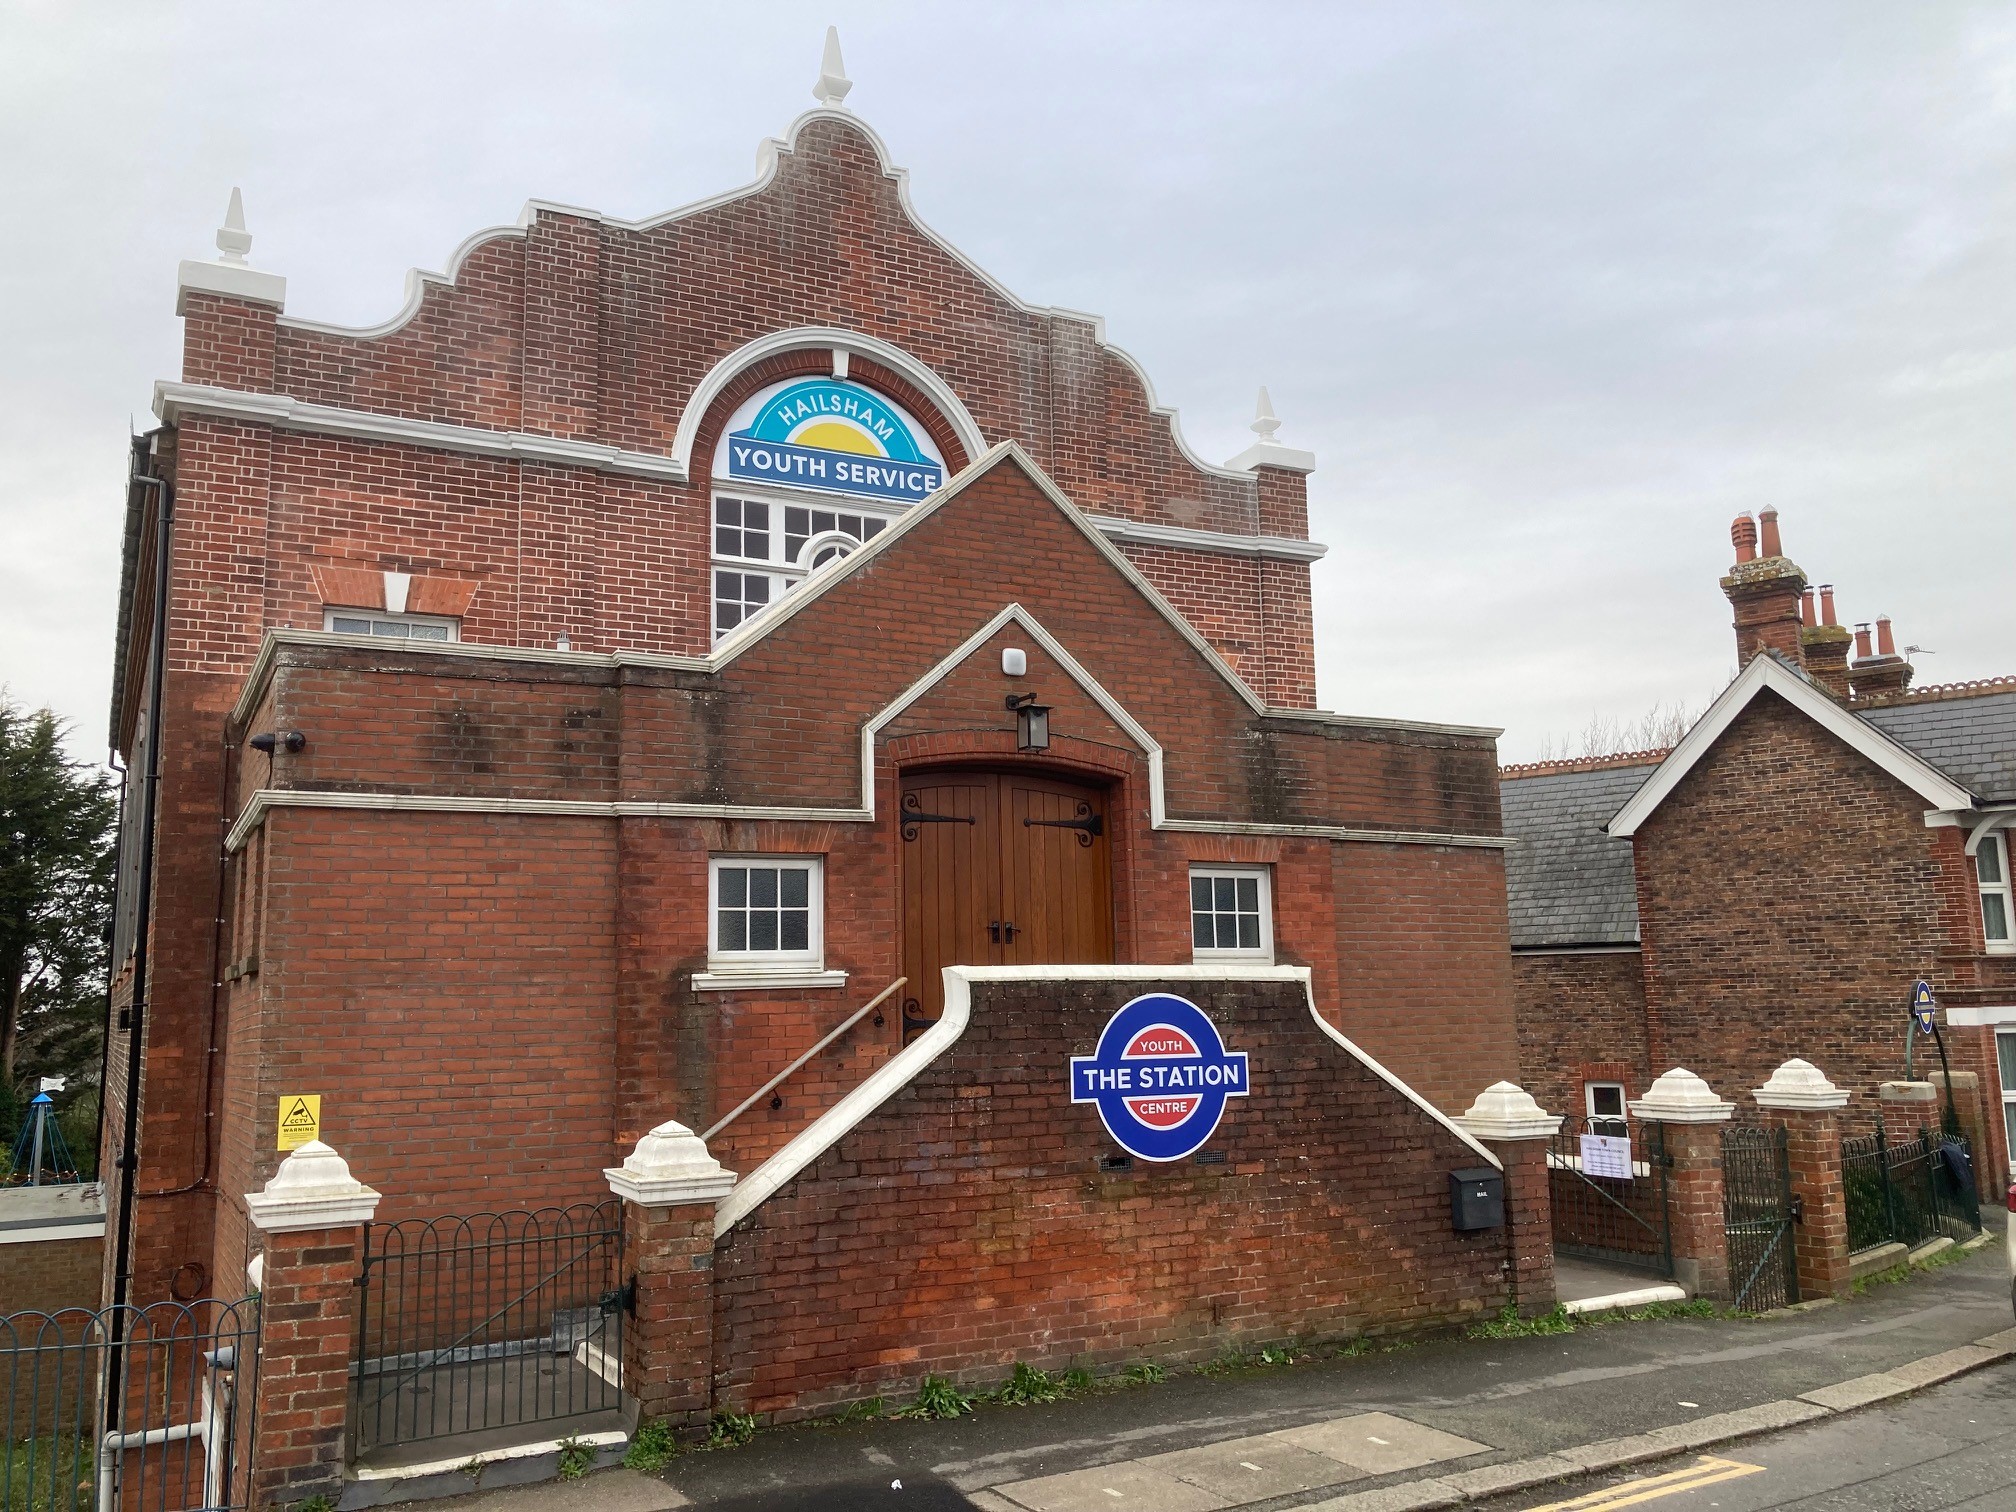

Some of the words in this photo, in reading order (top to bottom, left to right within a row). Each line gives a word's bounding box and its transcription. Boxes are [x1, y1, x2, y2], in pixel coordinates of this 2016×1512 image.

[777, 393, 895, 441] HAILSHAM
[734, 446, 826, 478] YOUTH
[835, 461, 937, 492] SERVICE
[1140, 1040, 1183, 1052] YOUTH
[1083, 1068, 1132, 1090] THE
[1139, 1064, 1239, 1088] STATION
[1140, 1101, 1188, 1115] CENTRE
